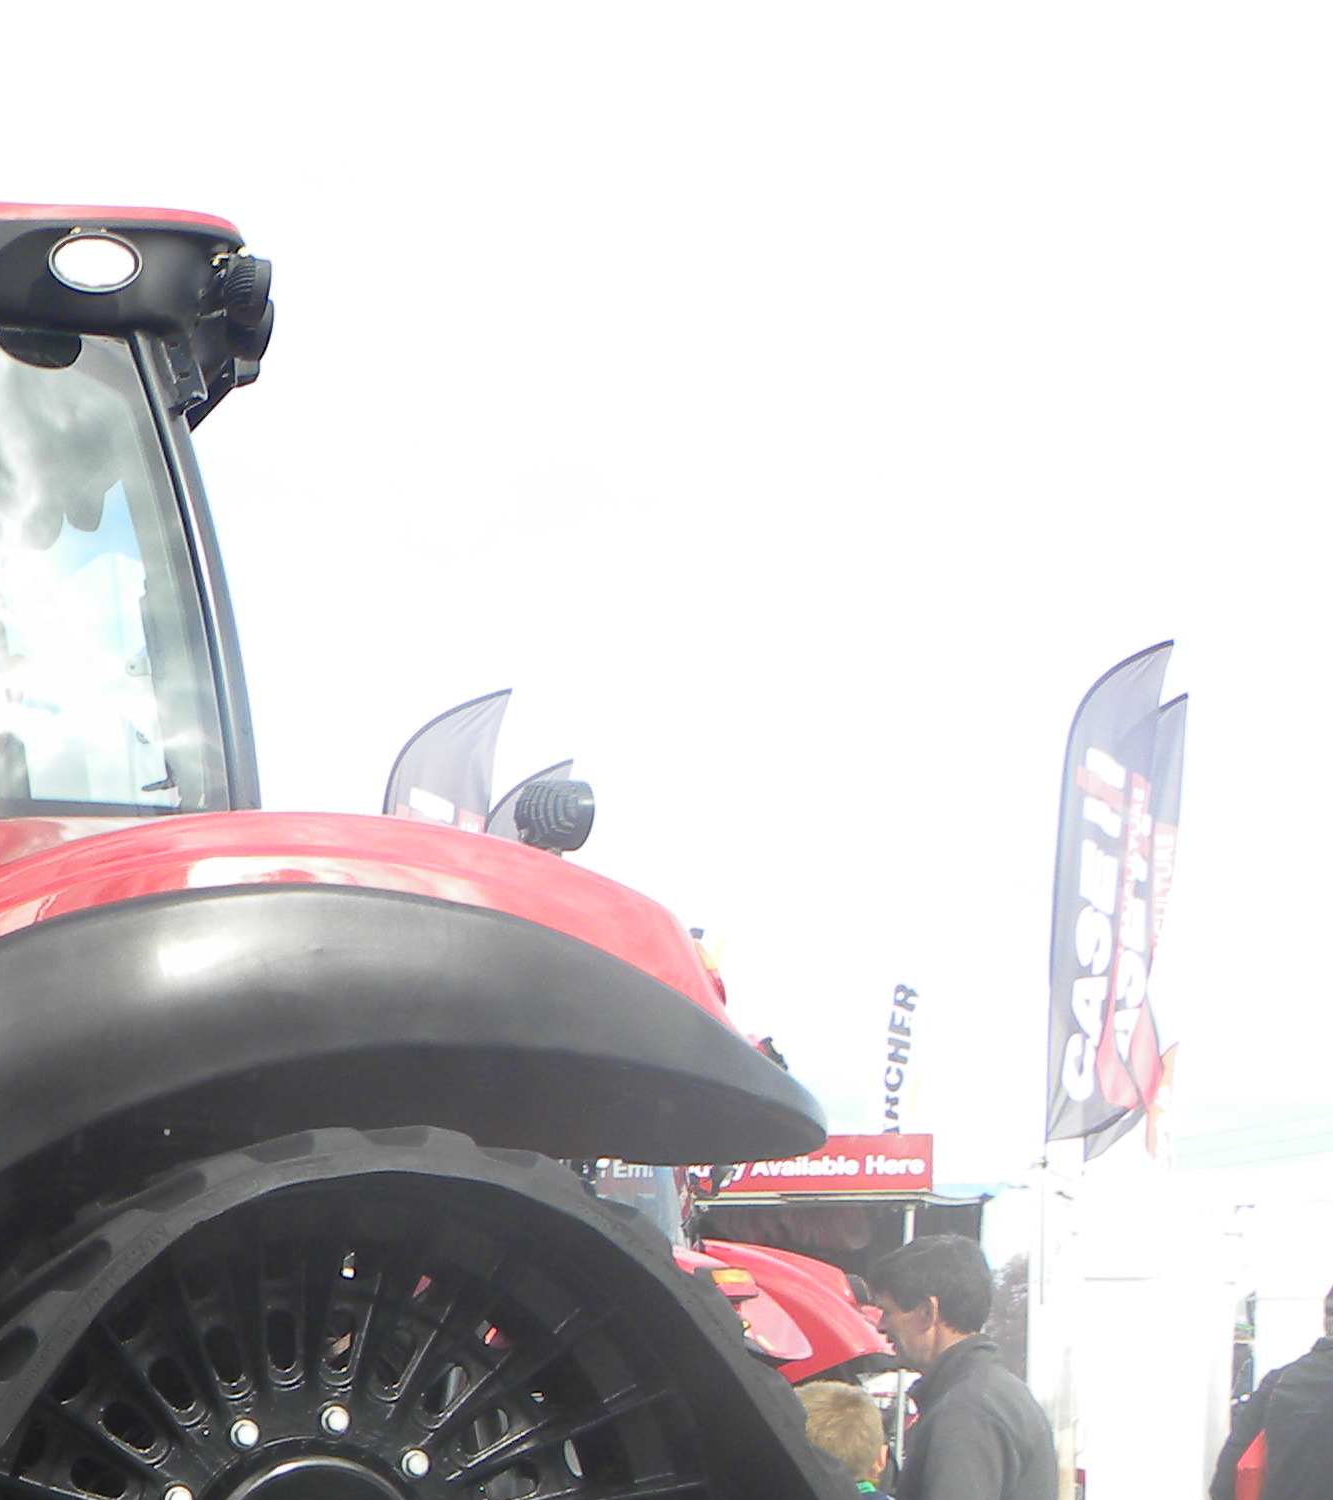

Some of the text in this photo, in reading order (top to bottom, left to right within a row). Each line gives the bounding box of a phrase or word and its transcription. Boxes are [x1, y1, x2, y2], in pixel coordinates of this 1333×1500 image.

[1061, 838, 1119, 1102] CASE
[750, 1155, 861, 1177] Available
[864, 1153, 926, 1175] Here
